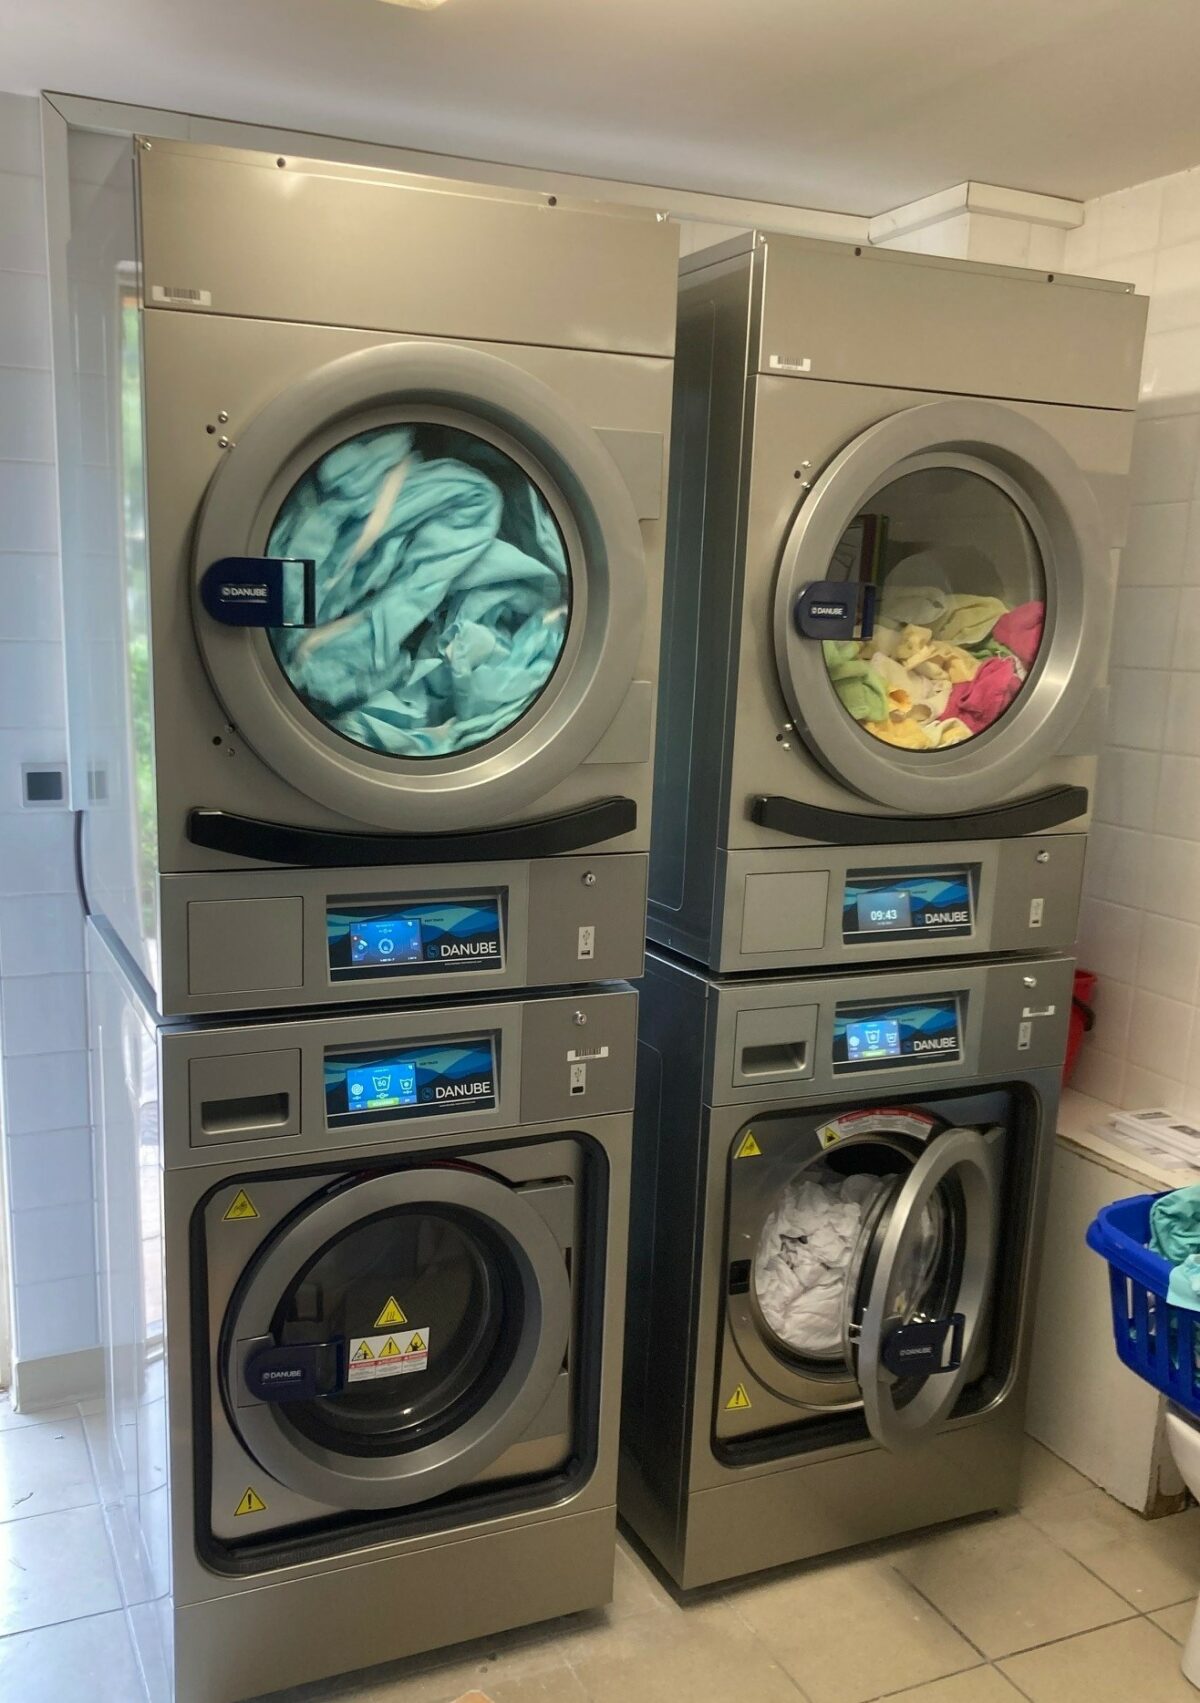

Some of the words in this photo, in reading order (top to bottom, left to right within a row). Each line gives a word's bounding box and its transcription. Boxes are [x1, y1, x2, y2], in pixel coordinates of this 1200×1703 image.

[231, 588, 268, 597] DANUBE
[817, 607, 843, 615] DANUBE
[870, 909, 897, 921] 09:43
[925, 911, 968, 925] DANUBE
[441, 941, 497, 957] DANUBE
[913, 1036, 956, 1051] DANUBE
[435, 1081, 491, 1099] DANUBE
[270, 1370, 302, 1378] DANUBE
